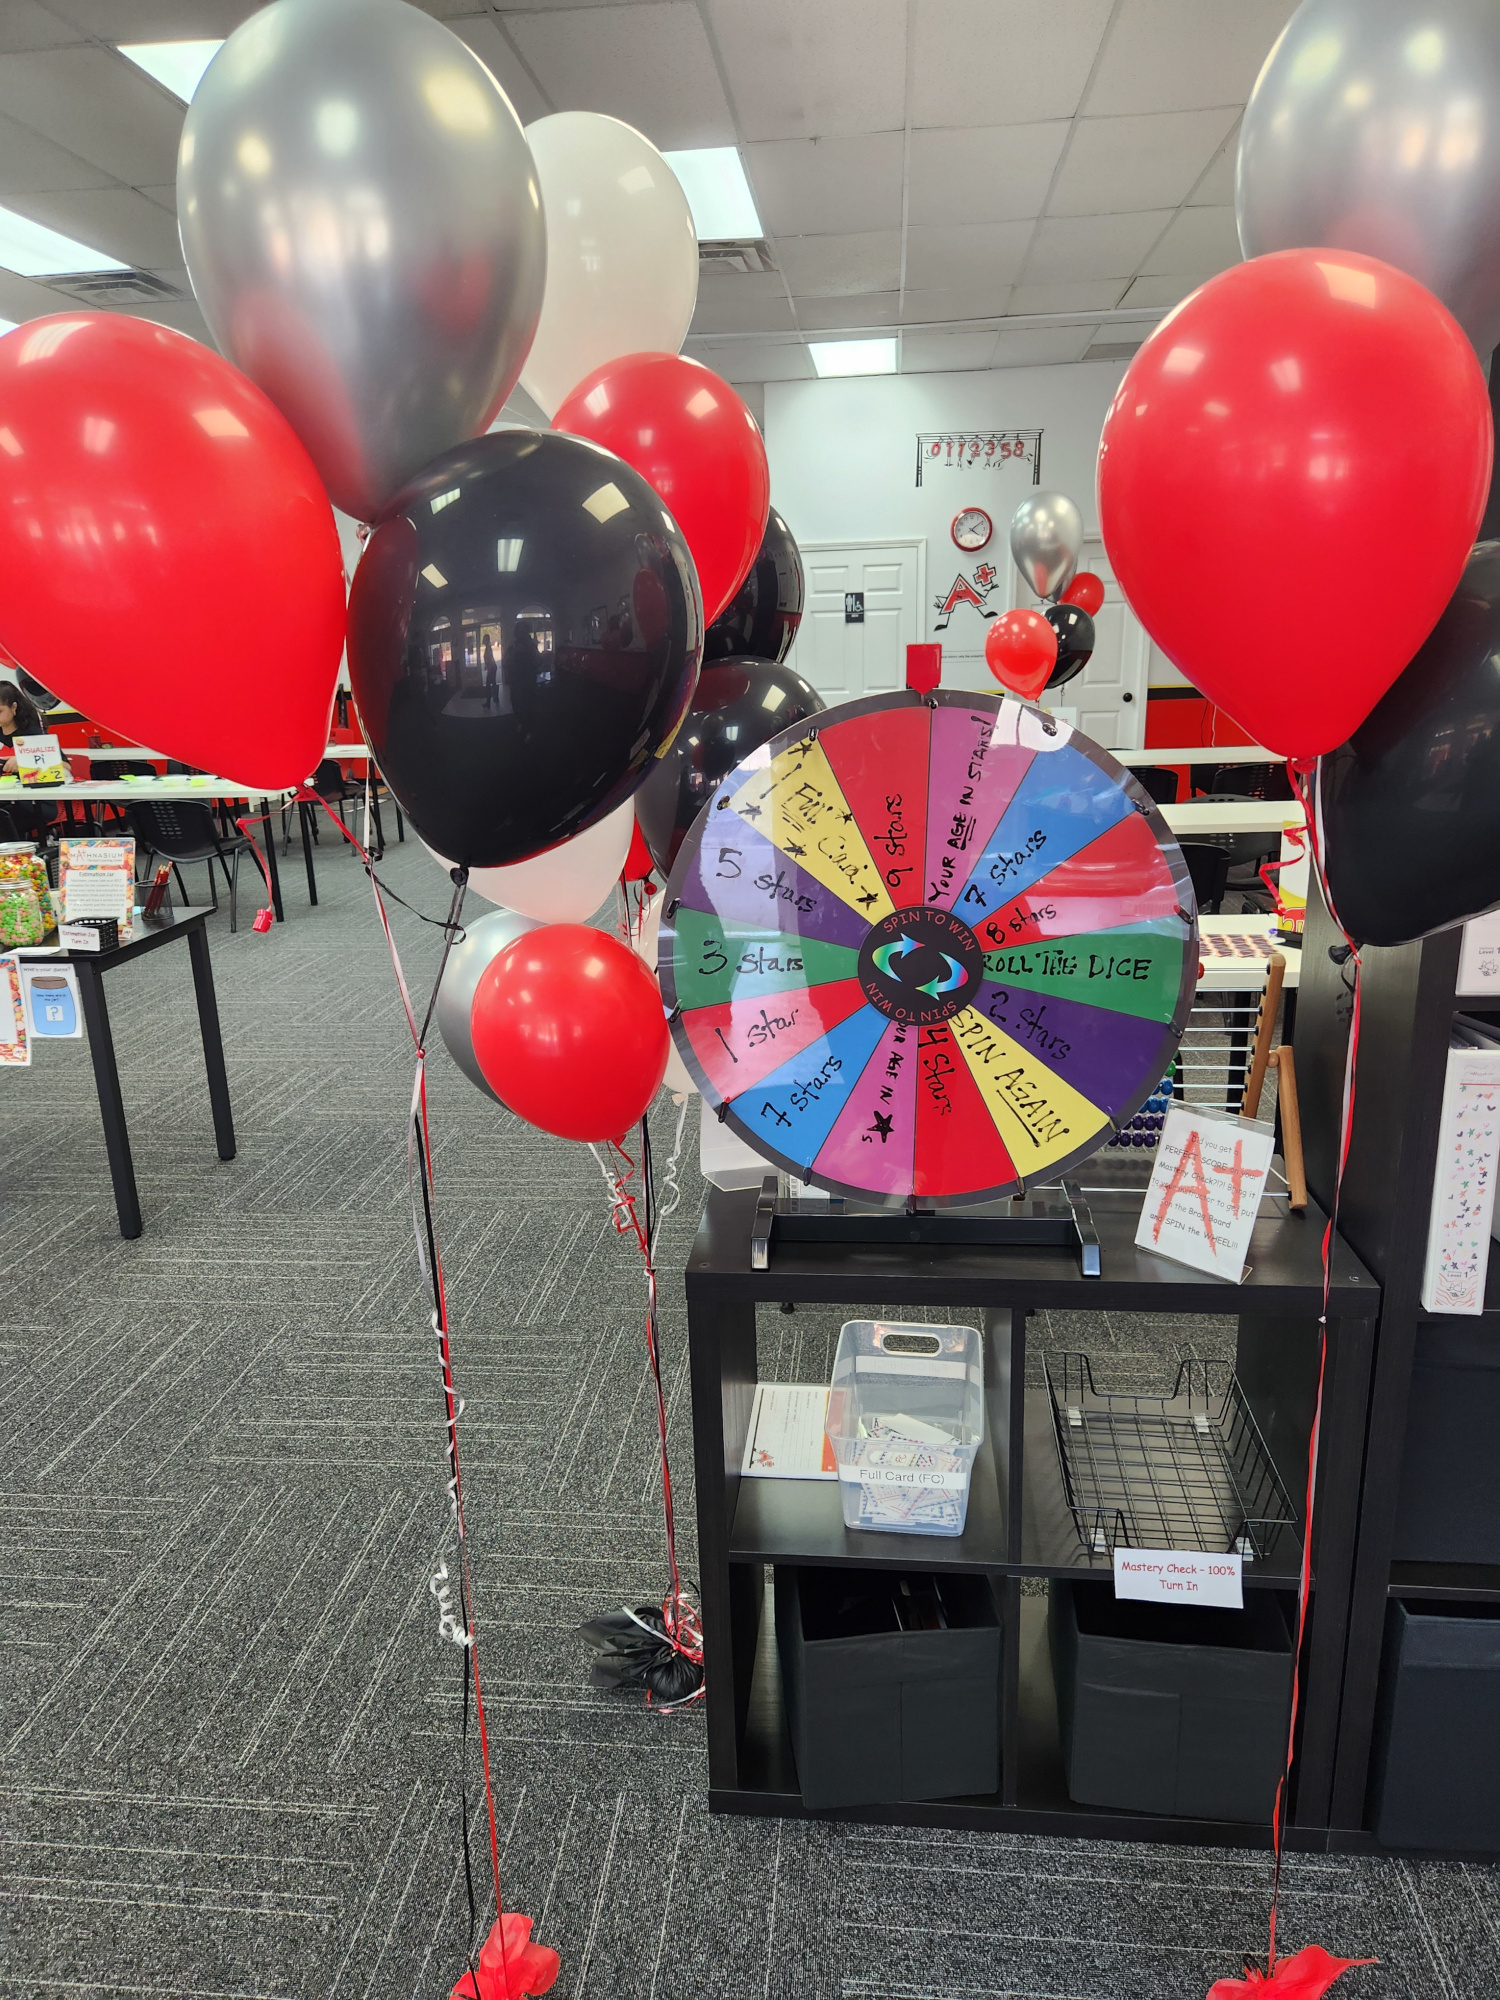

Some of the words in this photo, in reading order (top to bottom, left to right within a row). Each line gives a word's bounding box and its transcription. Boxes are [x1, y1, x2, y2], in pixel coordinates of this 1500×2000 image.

[19, 746, 56, 754] VISUALIZE
[928, 856, 956, 902] YOUR
[947, 812, 967, 849] AGE
[960, 786, 974, 805] IN
[968, 715, 993, 782] STARS!
[716, 848, 742, 878] 5
[886, 867, 913, 887] 9
[964, 884, 987, 907] 7
[883, 911, 920, 933] SPIN
[925, 911, 946, 925] TO
[948, 920, 976, 951] WIN
[986, 922, 1006, 944] 8
[698, 940, 728, 975] 3
[983, 954, 1033, 975] ROLL
[1089, 954, 1152, 980] DICE
[866, 983, 892, 1012] WIN
[989, 990, 1010, 1022] 2
[895, 1008, 915, 1021] TO
[921, 1001, 957, 1021] SPIN
[893, 1022, 907, 1043] OUR
[917, 1028, 949, 1048] 4
[885, 1051, 904, 1080] AGE
[950, 1009, 1006, 1063] SPIN
[994, 1068, 1070, 1142] AGAIN
[880, 1085, 894, 1105] IN
[761, 1102, 792, 1127] 7
[1192, 1135, 1204, 1145] Did
[1205, 1141, 1218, 1150] you
[1219, 1145, 1233, 1153] get
[1165, 1145, 1198, 1160] PERFECT
[1201, 1157, 1227, 1171] SCORE
[1241, 1171, 1259, 1180] your
[1158, 1161, 1189, 1177] Mastery
[1227, 1184, 1247, 1198] Bring
[1249, 1191, 1256, 1199] it
[1178, 1187, 1215, 1203] instructor
[1217, 1200, 1225, 1208] to
[1226, 1204, 1239, 1213] get
[1240, 1209, 1254, 1218] put
[1175, 1203, 1187, 1213] the
[1188, 1208, 1206, 1222] Brag
[1208, 1214, 1231, 1228] Board
[1149, 1213, 1163, 1222] and
[1165, 1218, 1185, 1230] SPIN
[1188, 1226, 1200, 1236] the
[1204, 1232, 1238, 1250] WHEEL!!!
[860, 1470, 882, 1480] Full
[885, 1471, 914, 1482] Card
[919, 1473, 945, 1485] (FC)
[1121, 1562, 1163, 1575] Mastery
[1166, 1564, 1197, 1574] Check
[1208, 1565, 1235, 1576] 100%
[1159, 1580, 1183, 1590] Turn
[1186, 1581, 1198, 1591] In
